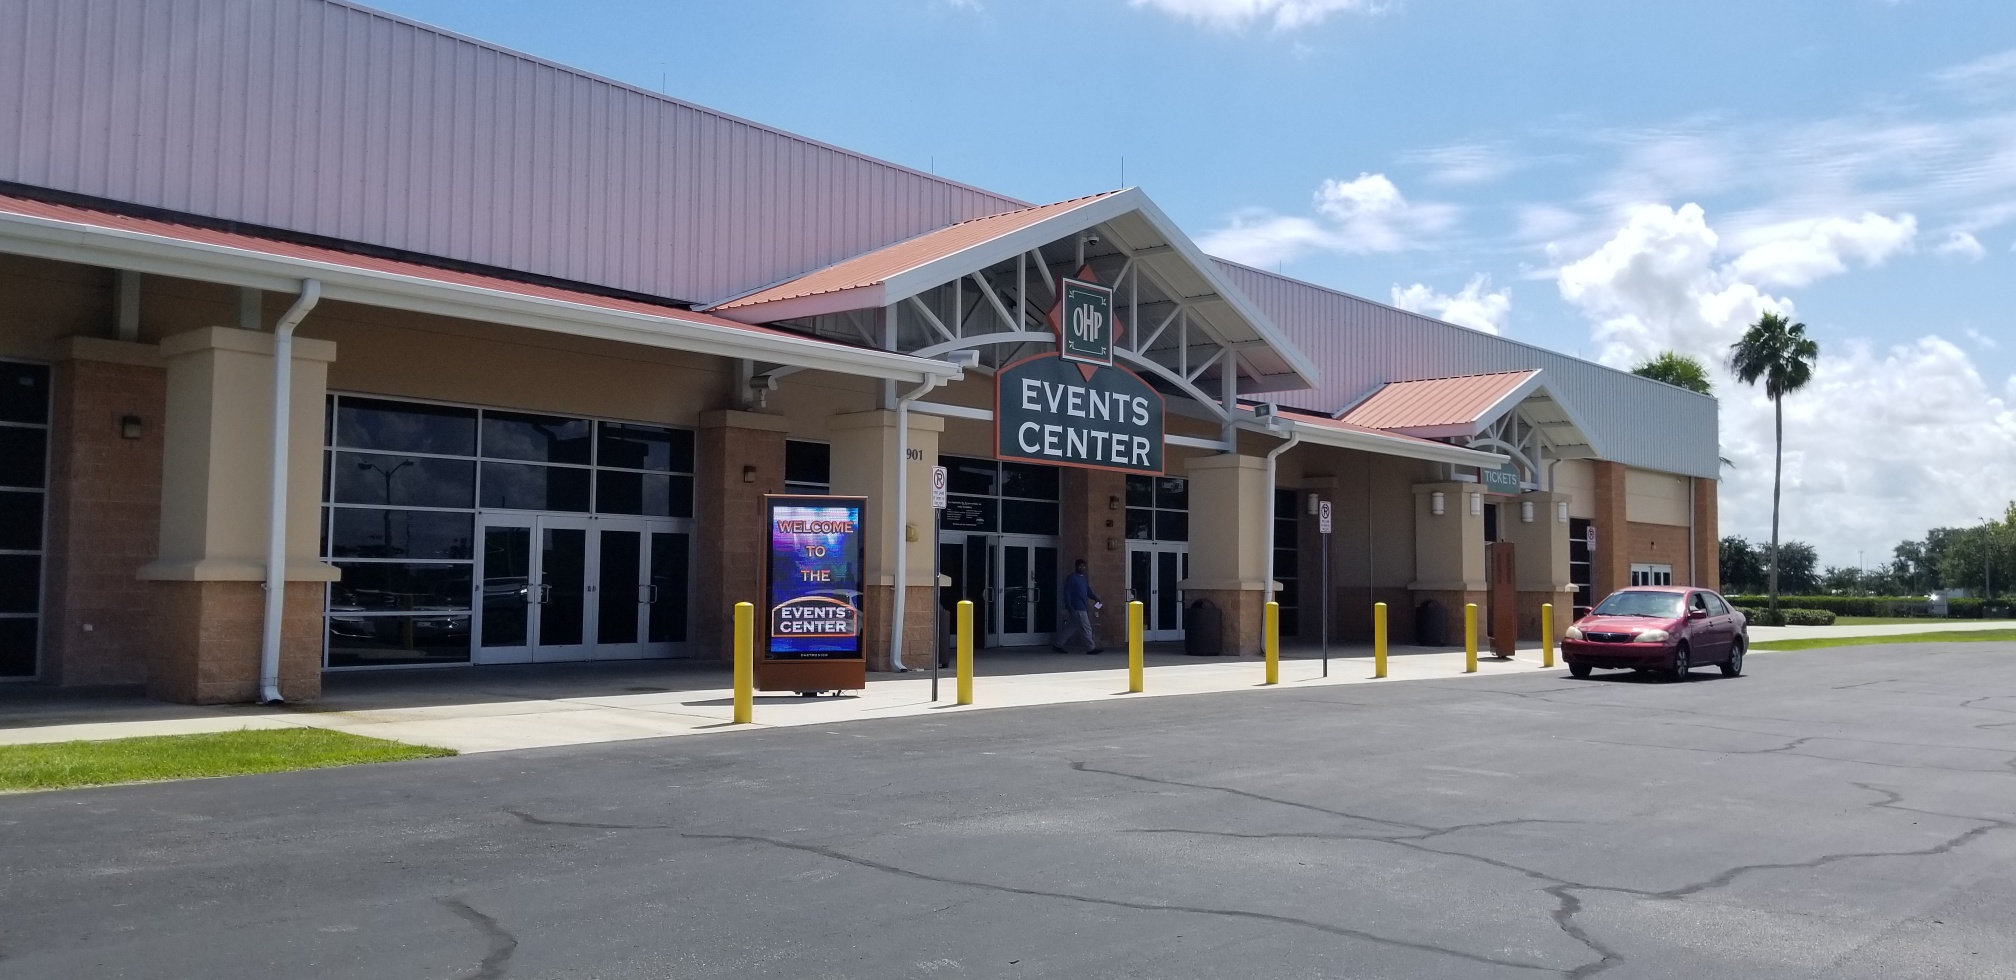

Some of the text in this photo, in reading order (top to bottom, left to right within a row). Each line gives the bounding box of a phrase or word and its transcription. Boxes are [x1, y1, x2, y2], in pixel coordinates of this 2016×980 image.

[1073, 303, 1103, 342] OHP
[1021, 378, 1150, 426] EVENTS
[1018, 421, 1151, 466] CENTER
[1484, 470, 1517, 485] TICKETS
[777, 520, 854, 534] WELCOME
[805, 545, 826, 558] TO
[800, 569, 831, 582] THE
[781, 606, 846, 619] EVENTS
[779, 620, 847, 633] CENTER
